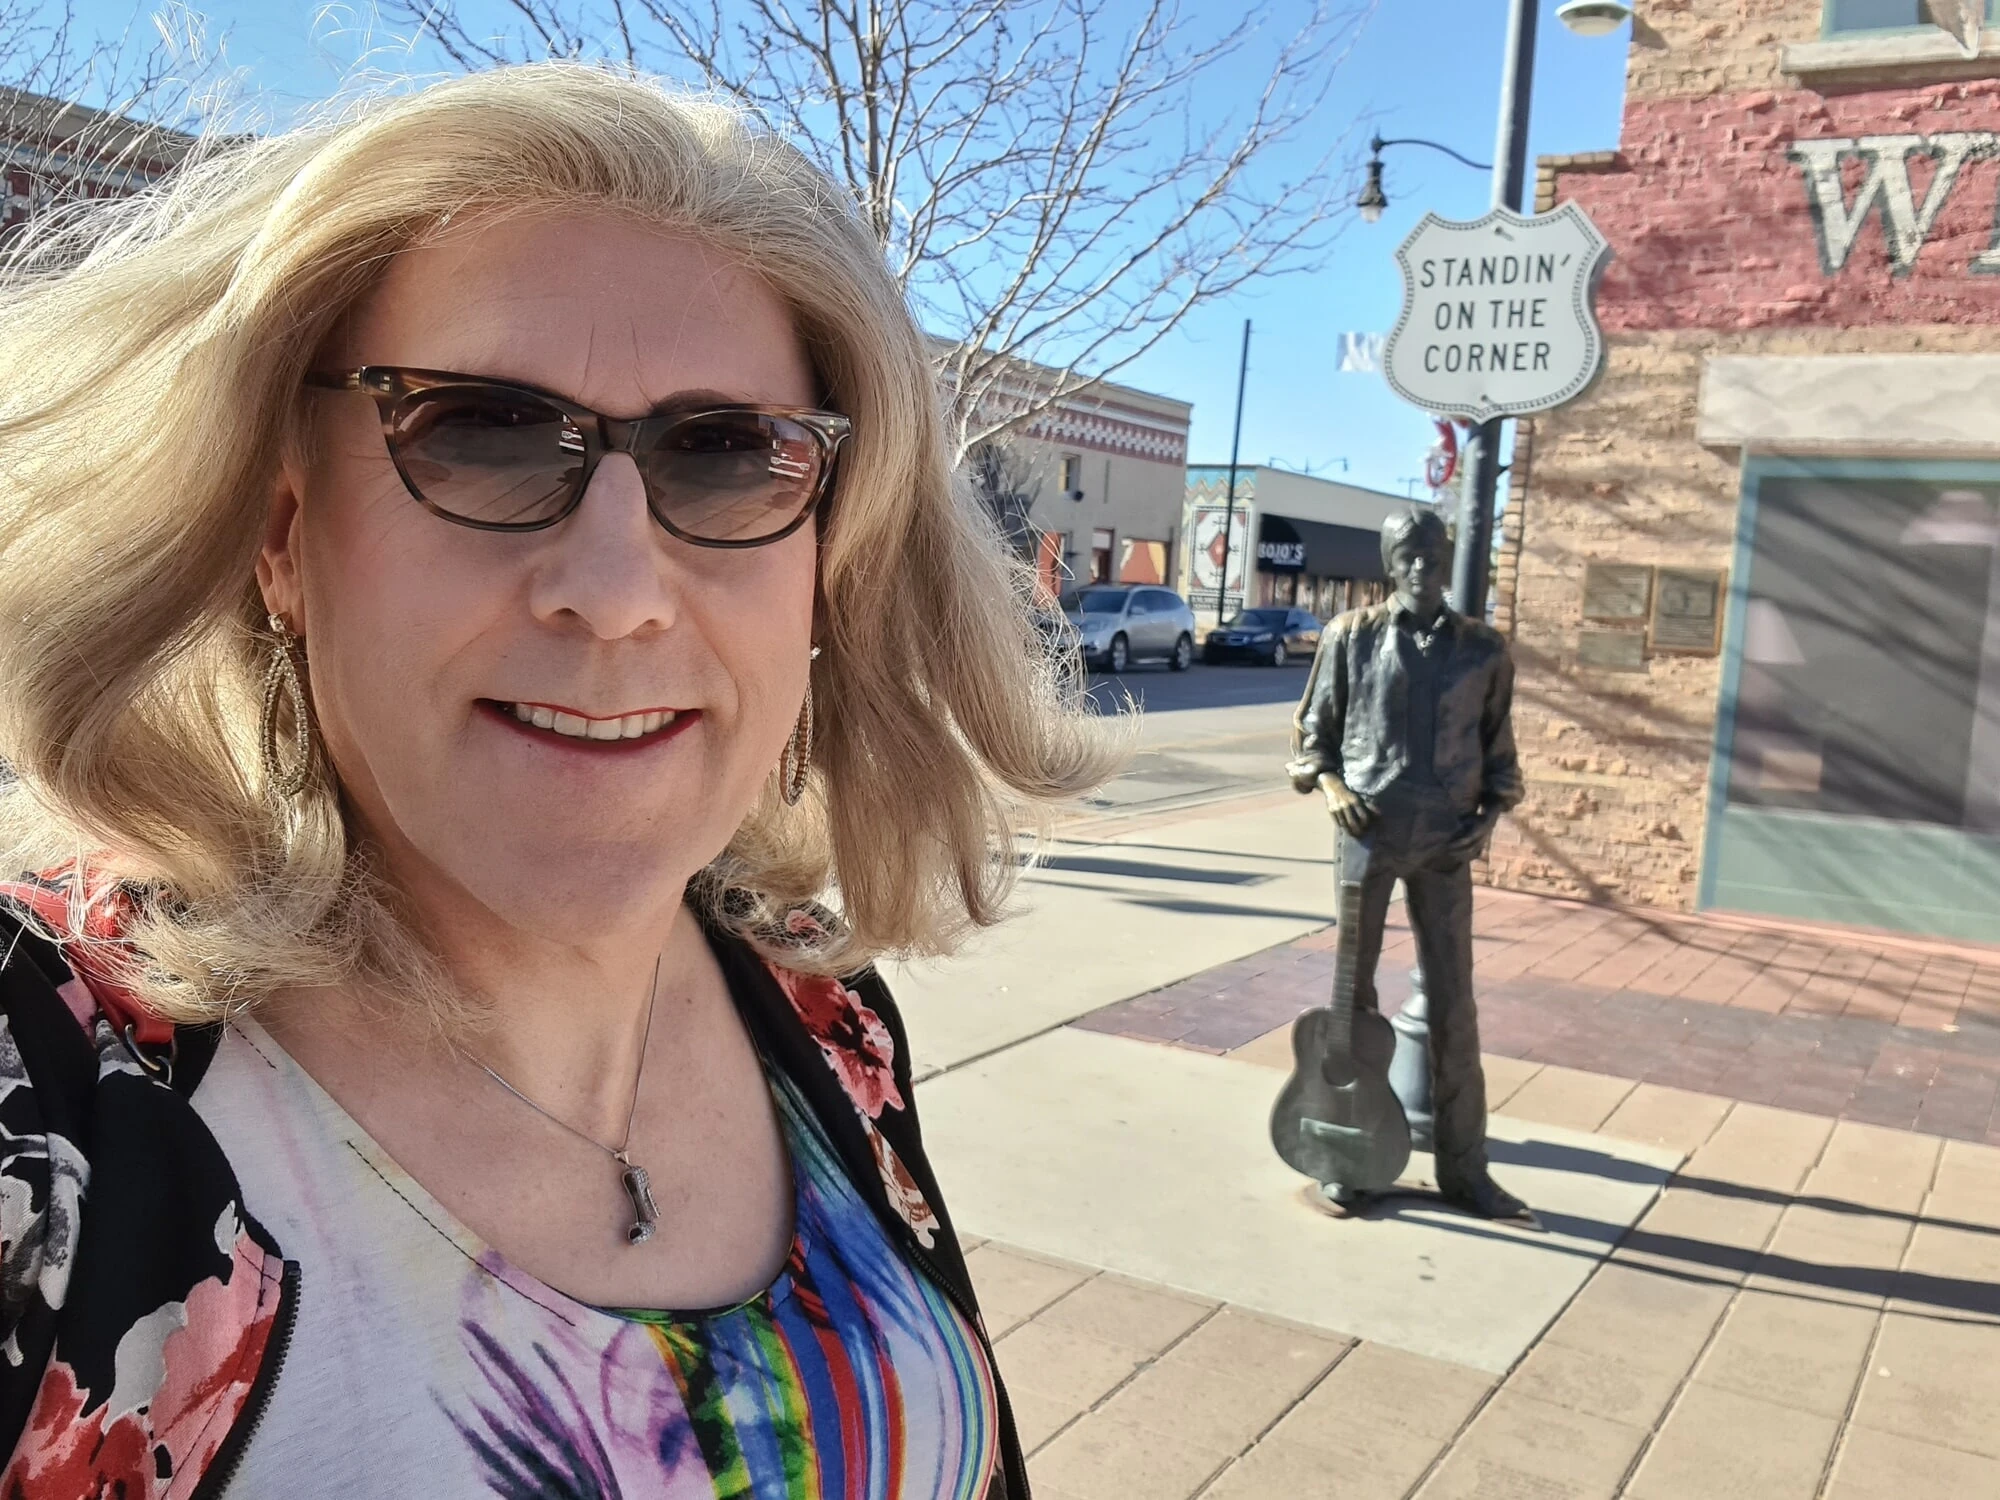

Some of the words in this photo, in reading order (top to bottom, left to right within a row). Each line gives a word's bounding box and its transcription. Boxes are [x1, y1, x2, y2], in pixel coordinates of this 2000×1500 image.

[1419, 253, 1572, 288] STANDIN'
[1434, 300, 1475, 331] ON
[1488, 298, 1549, 329] THE
[1423, 341, 1552, 374] CORNER
